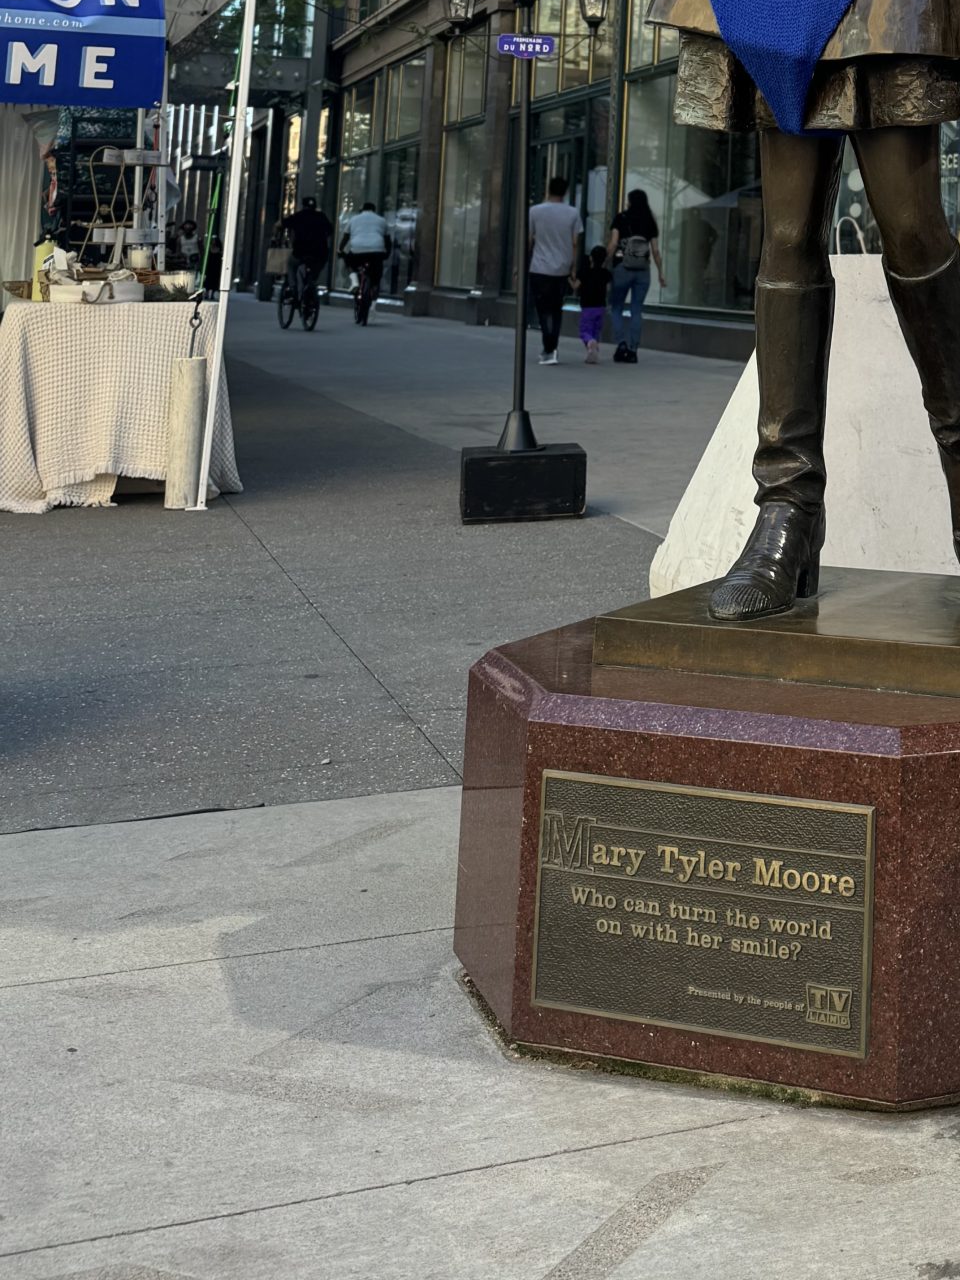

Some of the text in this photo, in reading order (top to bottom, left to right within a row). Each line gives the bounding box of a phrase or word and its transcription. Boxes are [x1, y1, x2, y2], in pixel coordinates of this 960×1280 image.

[0, 12, 84, 28] home.com
[5, 41, 116, 89] ME
[541, 810, 856, 897] Mary Tyler Moore
[571, 886, 833, 940] Who can turn the world
[596, 919, 802, 961] on with her smile?
[688, 986, 805, 1012] Presented by the people of
[811, 988, 849, 1013] TV
[809, 1010, 848, 1026] LAND
